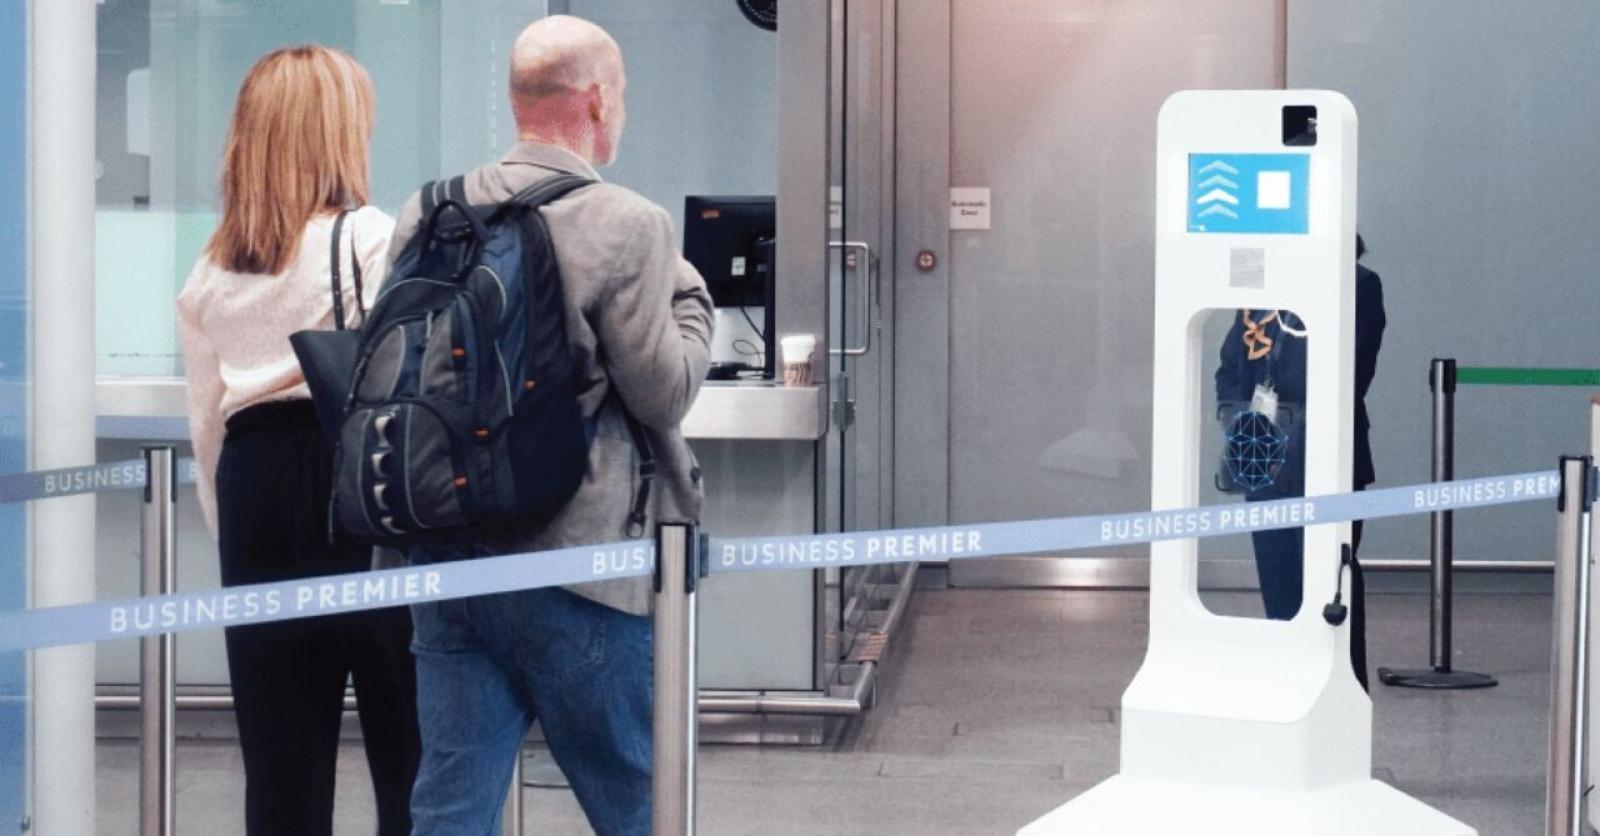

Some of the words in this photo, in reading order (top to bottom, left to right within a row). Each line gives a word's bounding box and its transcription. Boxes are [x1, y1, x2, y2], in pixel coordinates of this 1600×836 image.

[44, 464, 145, 492] BUSINESS
[1414, 481, 1506, 508] BUSINESS
[1513, 475, 1560, 497] PREM
[1101, 511, 1211, 540] BUSINESS
[1220, 502, 1316, 529] PREMIER
[593, 546, 655, 575] BUSI
[722, 539, 855, 566] BUSINESS
[867, 530, 981, 558] PREMIER
[110, 590, 281, 632] BUSINESS
[298, 571, 441, 611] PREMIER
